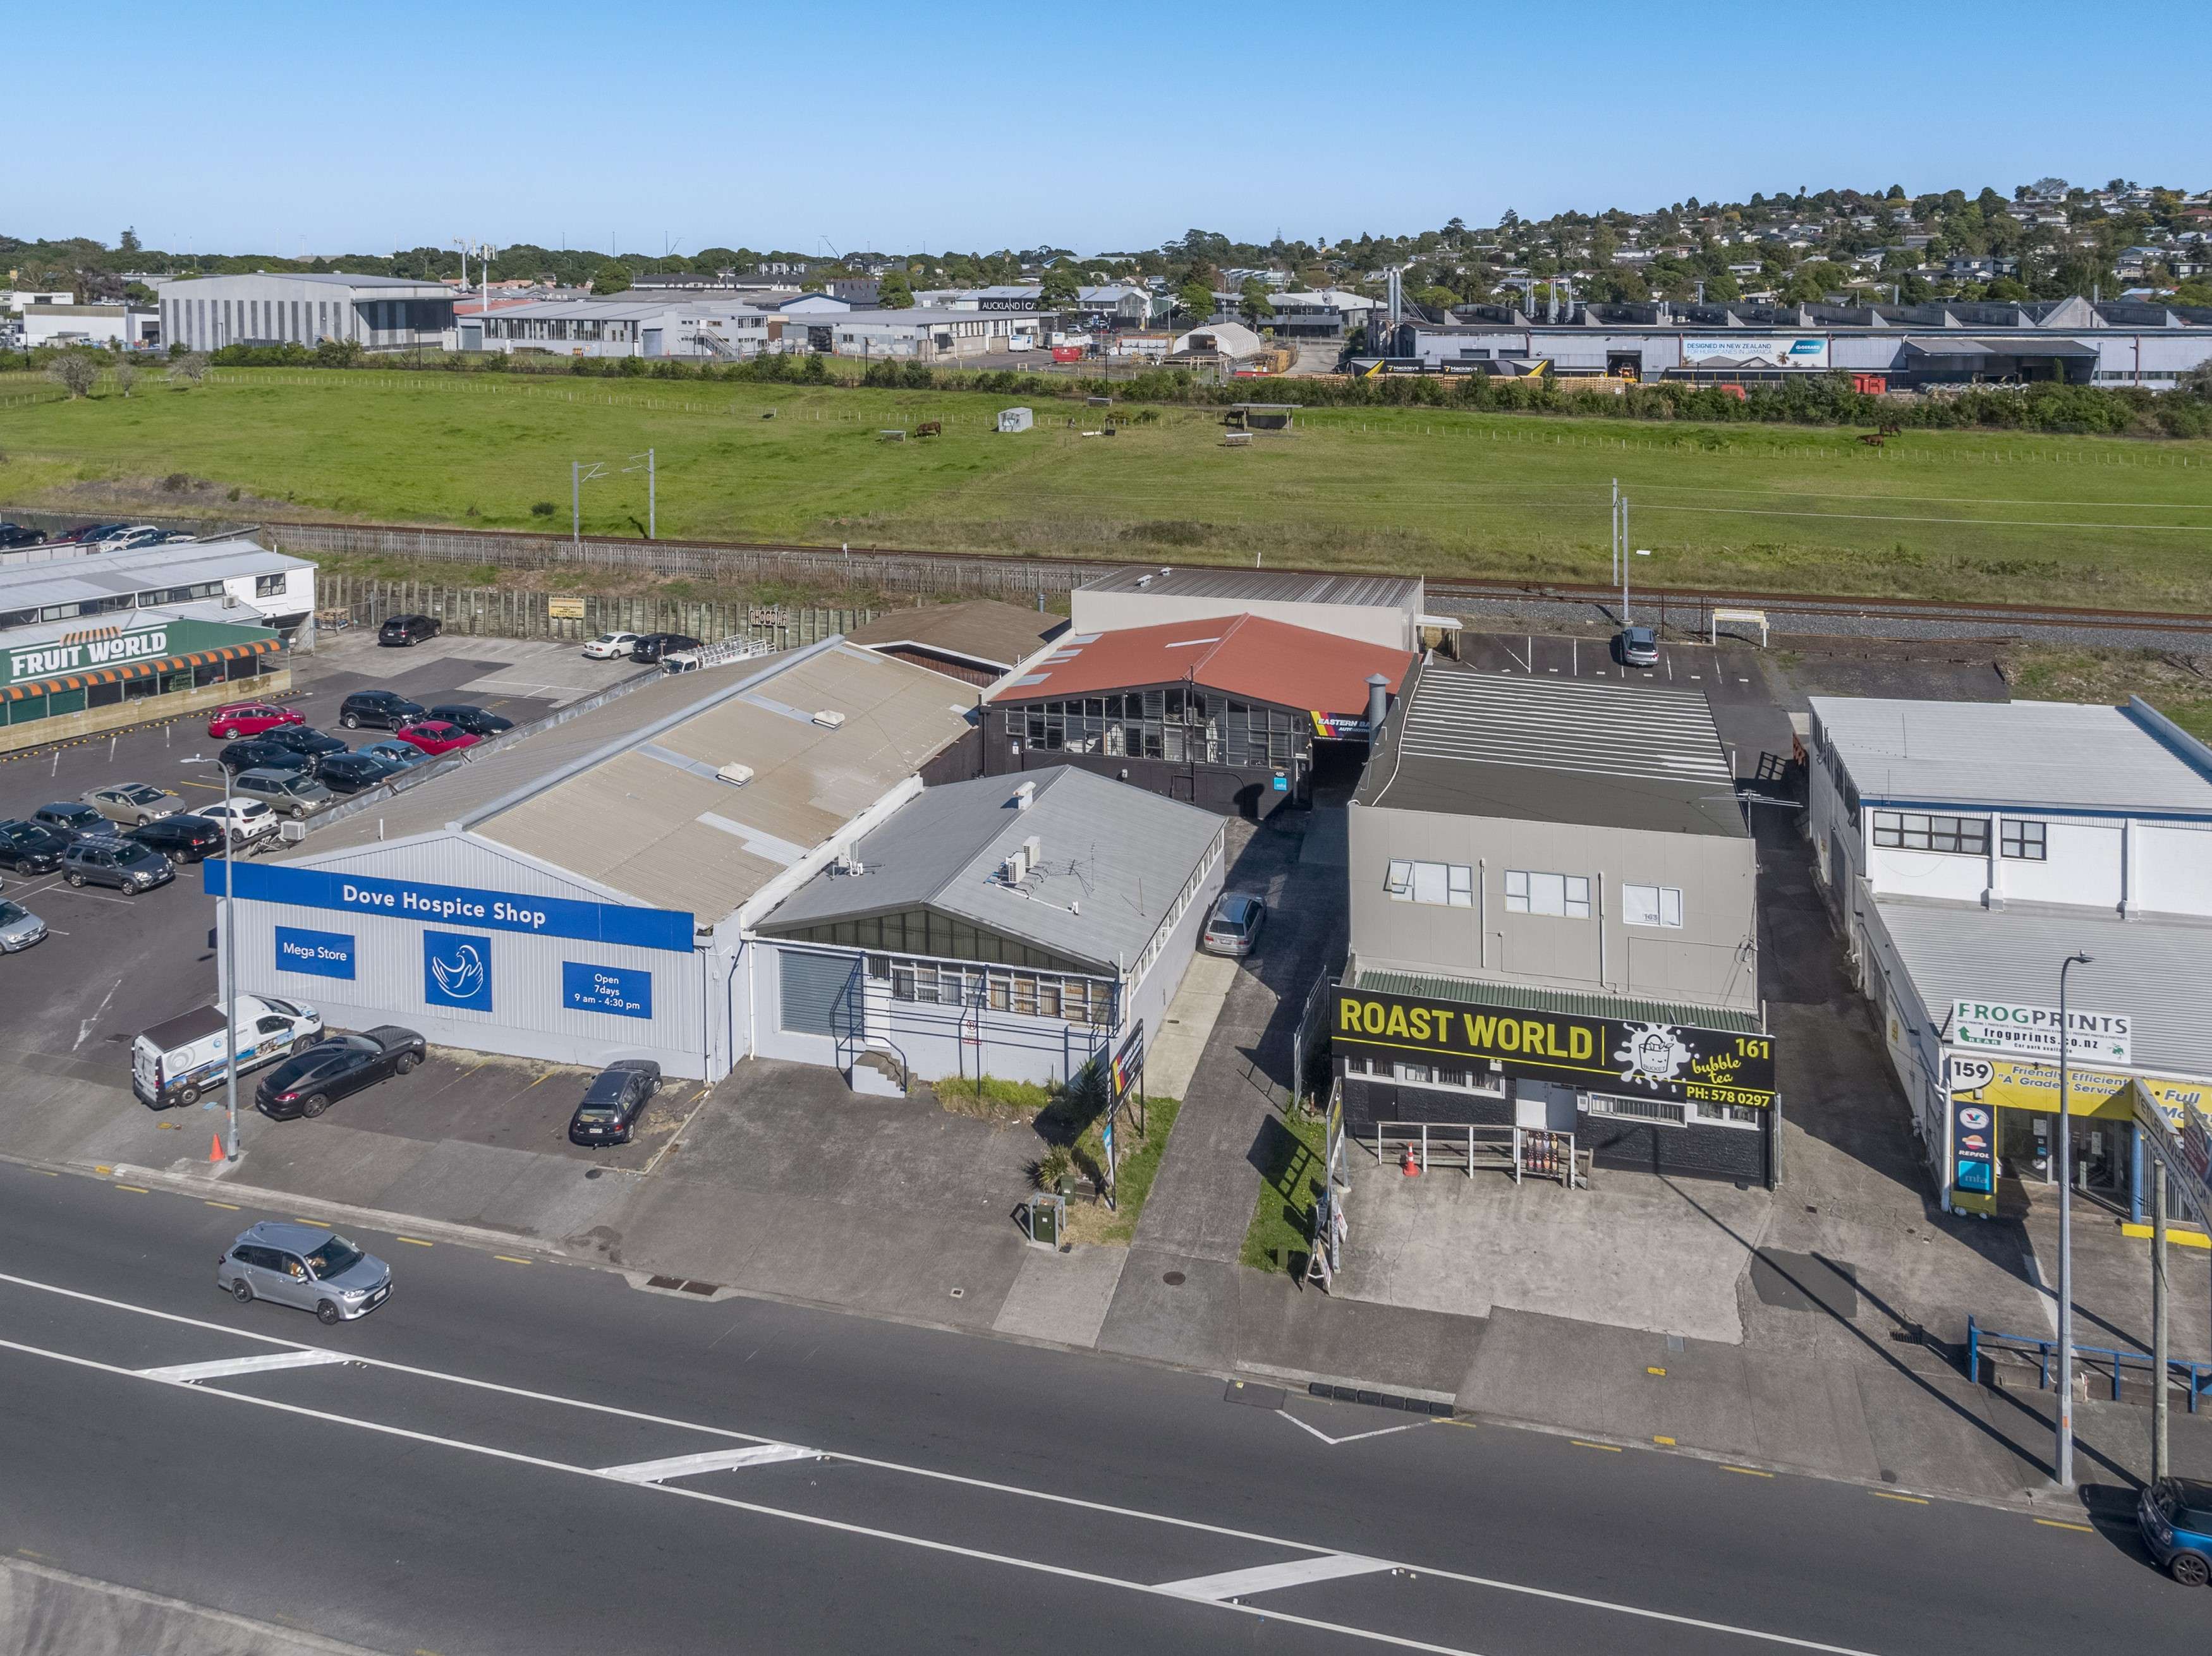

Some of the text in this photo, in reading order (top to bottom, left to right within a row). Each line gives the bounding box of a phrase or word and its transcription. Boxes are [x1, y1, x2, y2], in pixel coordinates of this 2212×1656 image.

[749, 610, 787, 626] CHOCOLA
[11, 645, 82, 677] FRUIT
[1318, 718, 1358, 727] EASTERN
[343, 885, 546, 928] Dove Hospice Shop
[283, 942, 347, 961] Mega Store
[595, 974, 619, 984] Open
[594, 984, 620, 997] 7days
[604, 998, 623, 1007] 4:30
[1958, 1003, 2128, 1034] FROGPRINTS
[1340, 998, 1593, 1060] ROAST WORLD
[1735, 1038, 1769, 1060] 161
[1969, 1036, 1998, 1045] REAR
[1692, 1053, 1742, 1074] bubble
[1954, 1061, 1988, 1079] 159
[1708, 1071, 1733, 1084] tea
[2012, 1067, 2129, 1087] Friendly Efficient
[1687, 1086, 1770, 1107] PH: 578 0297
[2074, 1084, 2125, 1097] Service
[2164, 1090, 2200, 1104] Full
[1959, 1150, 1990, 1159] REPSOL
[2136, 1090, 2164, 1139] TETLEY
[2166, 1133, 2210, 1209] WHEATON
[2147, 1135, 2184, 1194] Autootive
[1965, 1174, 1988, 1183] mta
